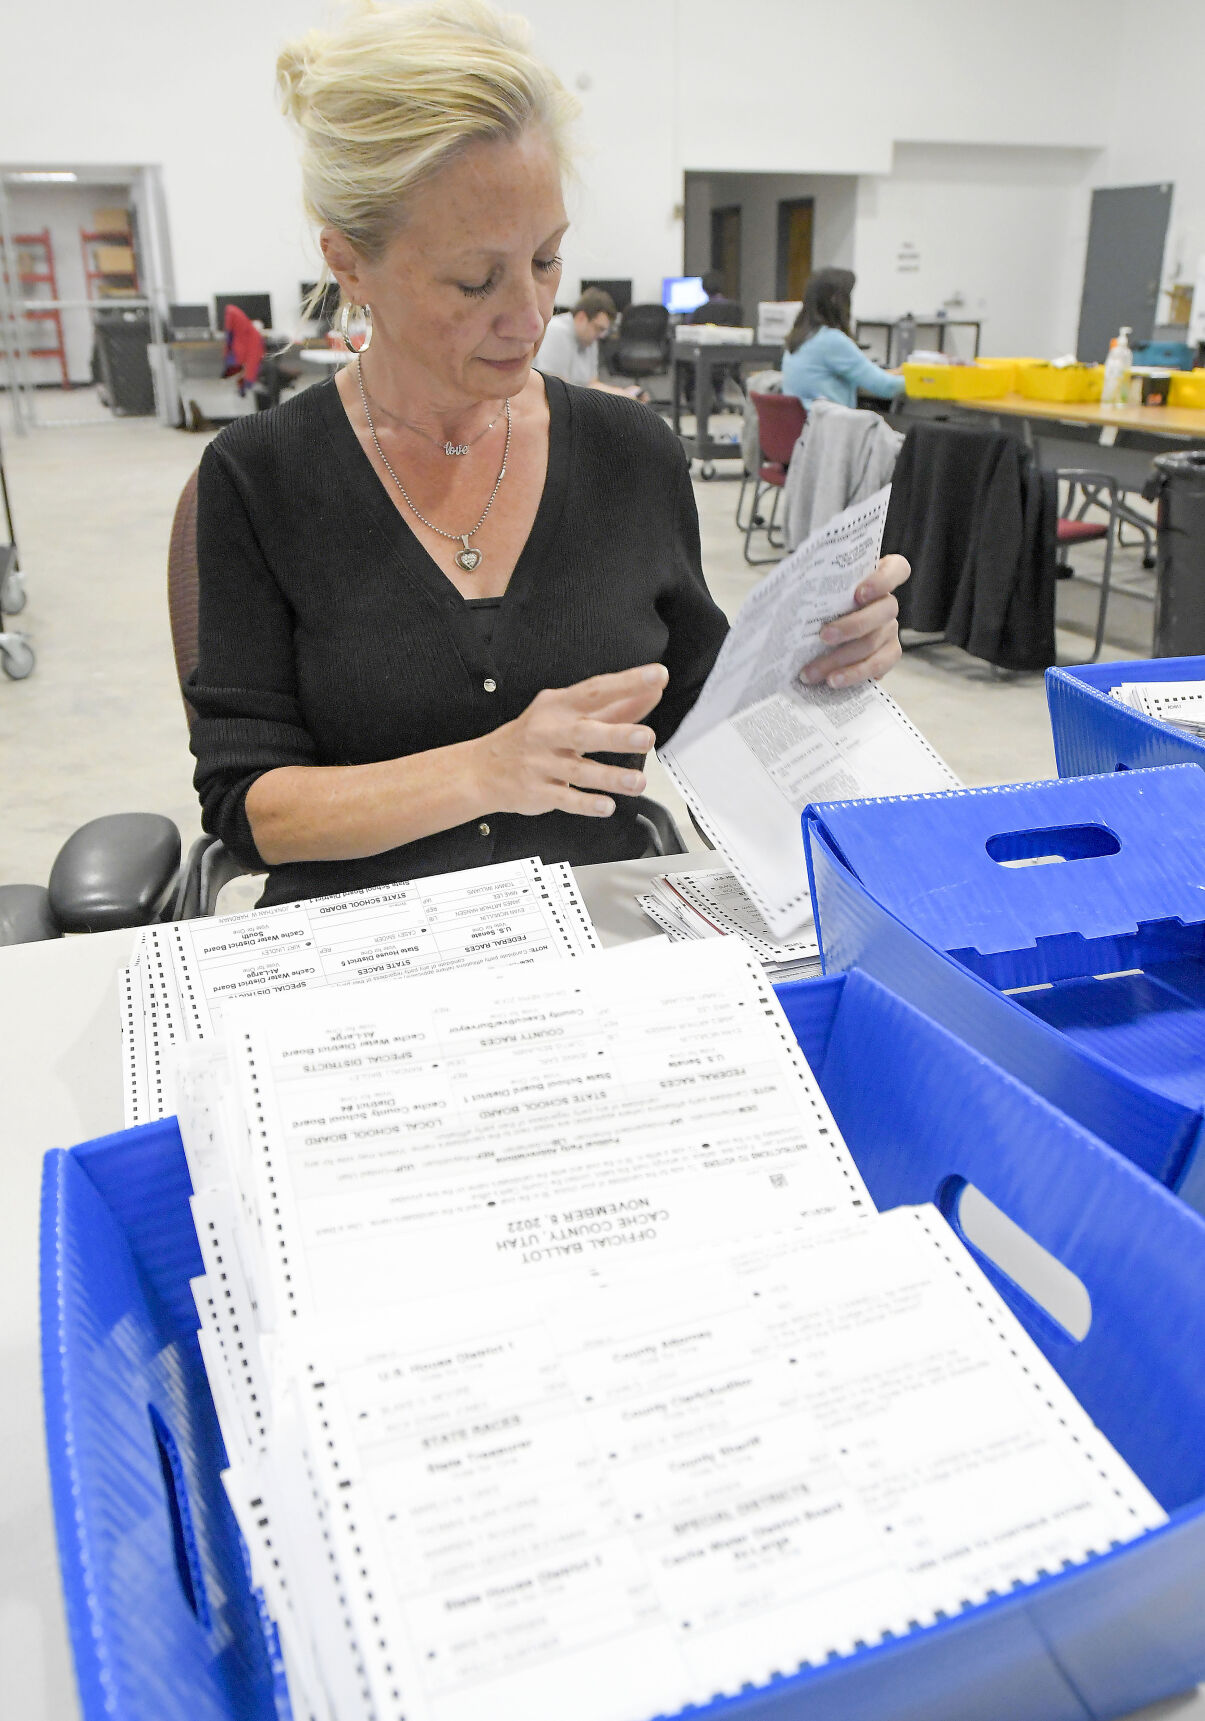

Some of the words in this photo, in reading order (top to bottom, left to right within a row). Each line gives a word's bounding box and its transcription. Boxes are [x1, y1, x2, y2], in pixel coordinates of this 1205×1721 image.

[444, 441, 470, 456] love
[382, 892, 406, 901] STATE
[348, 897, 380, 907] SCHOOL
[319, 903, 347, 913] BOARD
[241, 931, 263, 939] South
[257, 934, 279, 942] Water
[471, 929, 495, 938] Senate
[228, 939, 255, 948] District
[492, 934, 526, 945] FEDERAL
[203, 944, 226, 953] Board
[464, 942, 490, 952] RACES
[375, 950, 399, 958] House
[347, 955, 374, 964] District
[386, 959, 410, 969] STATE
[246, 968, 278, 978] At-Large
[291, 967, 315, 975] Cache
[357, 965, 384, 975] RACES
[267, 972, 289, 980] Water
[238, 977, 265, 986] District
[272, 981, 306, 992] SPECIAL
[213, 983, 236, 992] Board
[393, 1033, 424, 1041] Cache
[521, 1028, 563, 1039] COUNTY
[360, 1038, 389, 1046] Water
[480, 1035, 516, 1046] RACES
[317, 1042, 356, 1052] District
[282, 1048, 314, 1057] Board
[367, 1051, 412, 1063] SPECIAL
[303, 1058, 362, 1072] DISTRICTS
[586, 1072, 611, 1080] State
[699, 1068, 745, 1080] FEDERAL
[547, 1076, 582, 1087] School
[659, 1077, 695, 1087] RACES
[512, 1083, 544, 1093] Board
[474, 1089, 510, 1100] District
[573, 1091, 606, 1102] STATE
[413, 1101, 446, 1110] Cache
[524, 1097, 568, 1110] SCHOOL
[371, 1104, 409, 1116] County
[479, 1105, 519, 1118] BOARD
[292, 1117, 325, 1127] Board
[329, 1112, 367, 1122] School
[405, 1119, 441, 1129] LOCAL
[353, 1125, 399, 1137] SCHOOL
[305, 1133, 347, 1144] BOARD
[563, 1198, 648, 1220] NOVEMBER
[617, 1210, 668, 1227] CACHE
[507, 1217, 540, 1232] 2022
[496, 1234, 538, 1249] UTAH
[589, 1228, 656, 1247] OFFICIAL
[522, 1242, 582, 1263] BALLOT
